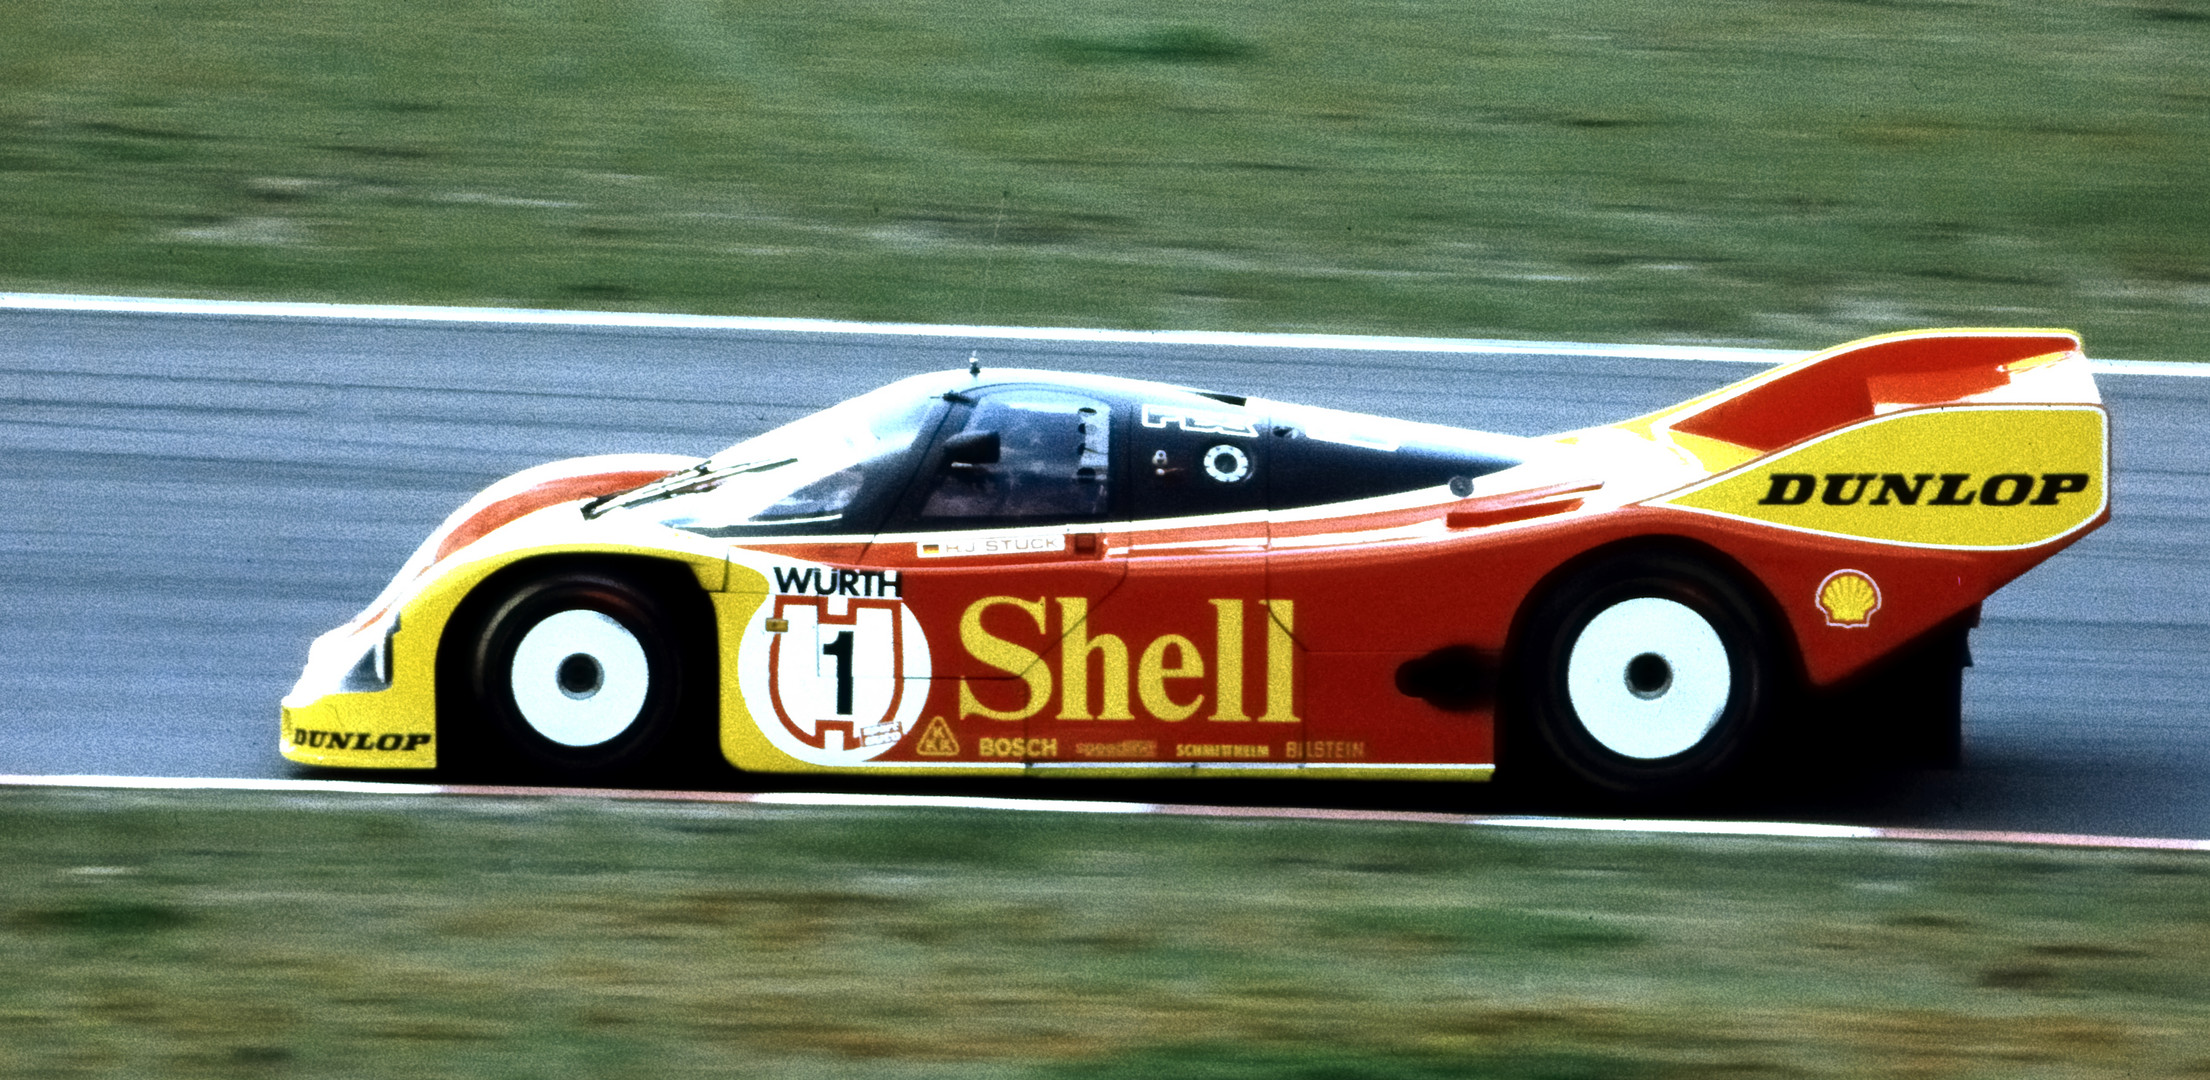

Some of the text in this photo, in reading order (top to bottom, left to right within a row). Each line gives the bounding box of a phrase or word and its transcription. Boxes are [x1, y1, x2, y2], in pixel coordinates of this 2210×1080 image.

[1757, 473, 2090, 506] DUNLOP
[986, 538, 1058, 551] STUCK
[959, 595, 1301, 723] Shell
[823, 630, 854, 715] 1
[293, 728, 432, 751] DUNLOP
[979, 737, 1058, 757] BOSCH
[1286, 740, 1365, 758] BILSTEIN
